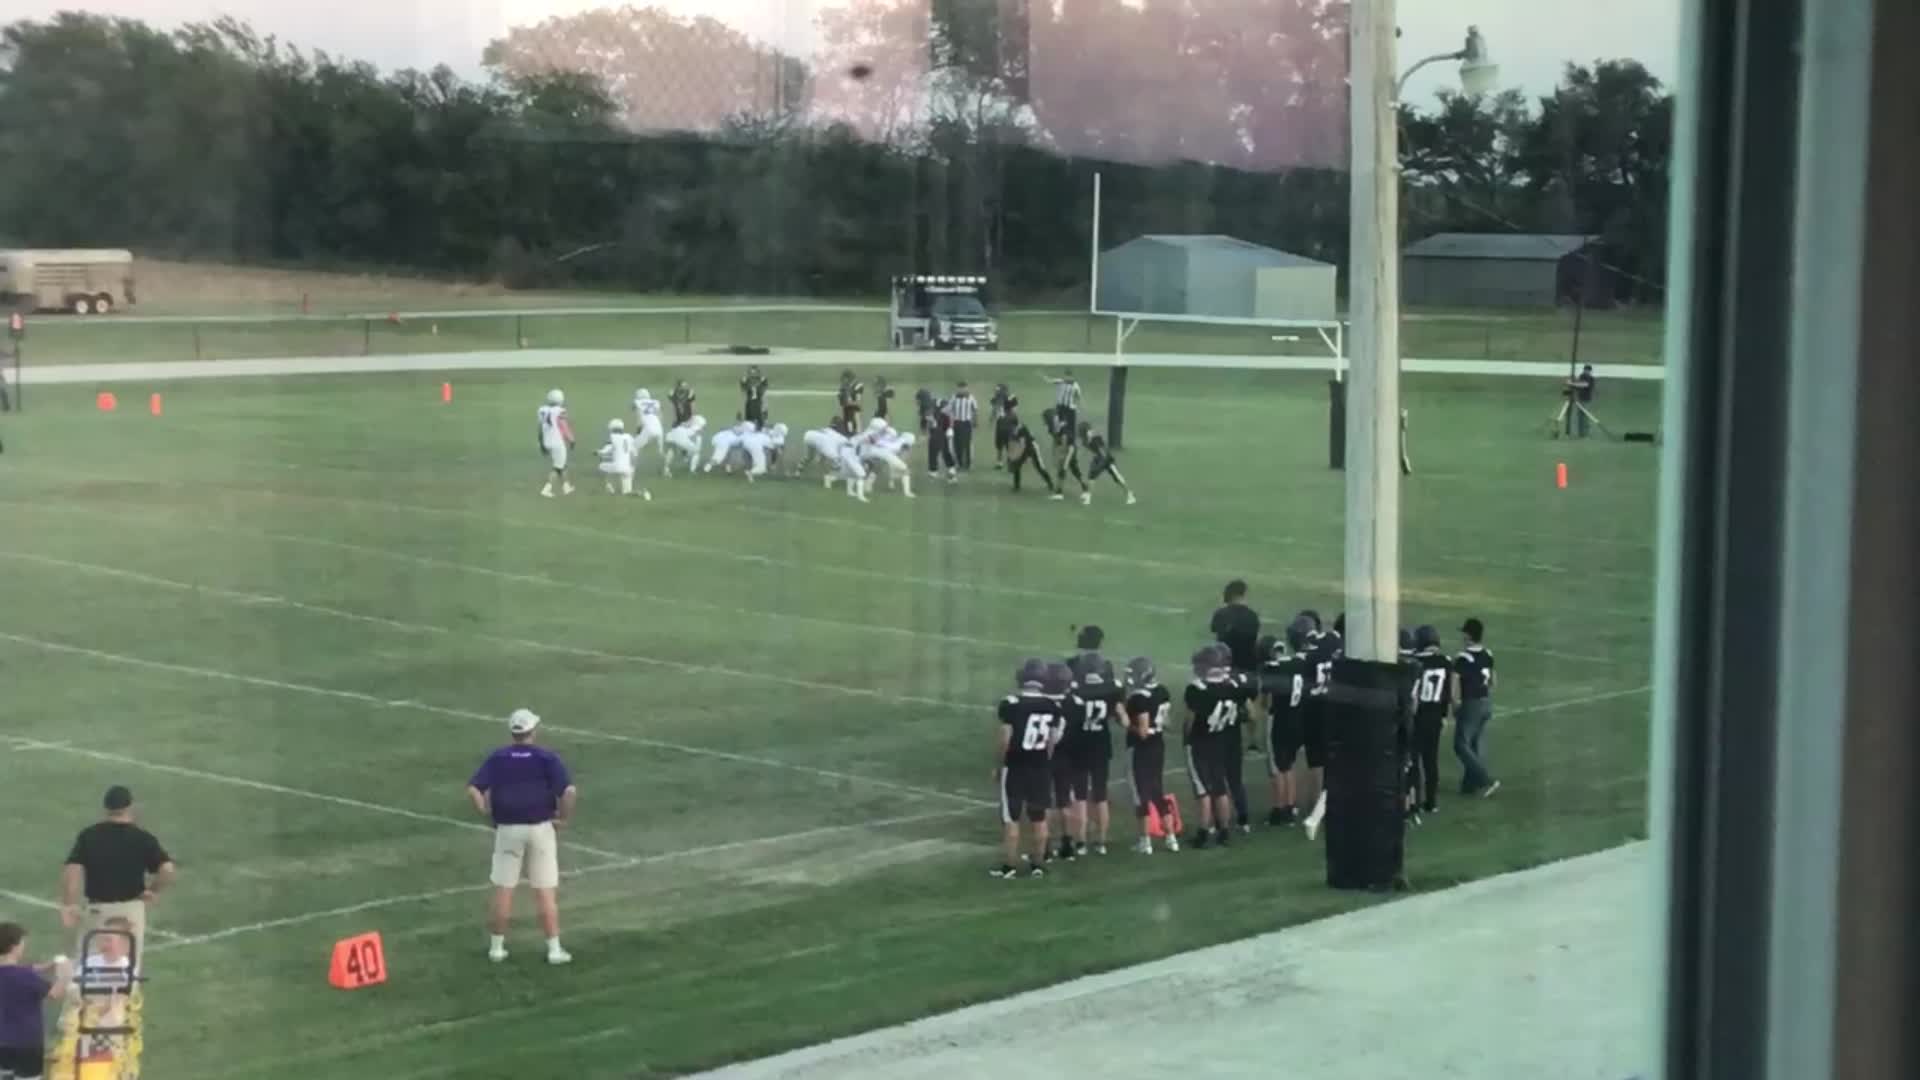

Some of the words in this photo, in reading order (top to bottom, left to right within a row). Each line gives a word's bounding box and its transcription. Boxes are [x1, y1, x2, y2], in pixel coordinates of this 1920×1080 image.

[1420, 667, 1446, 702] 67
[1022, 713, 1054, 750] 65
[1082, 700, 1108, 731] 12
[347, 940, 380, 983] 40
